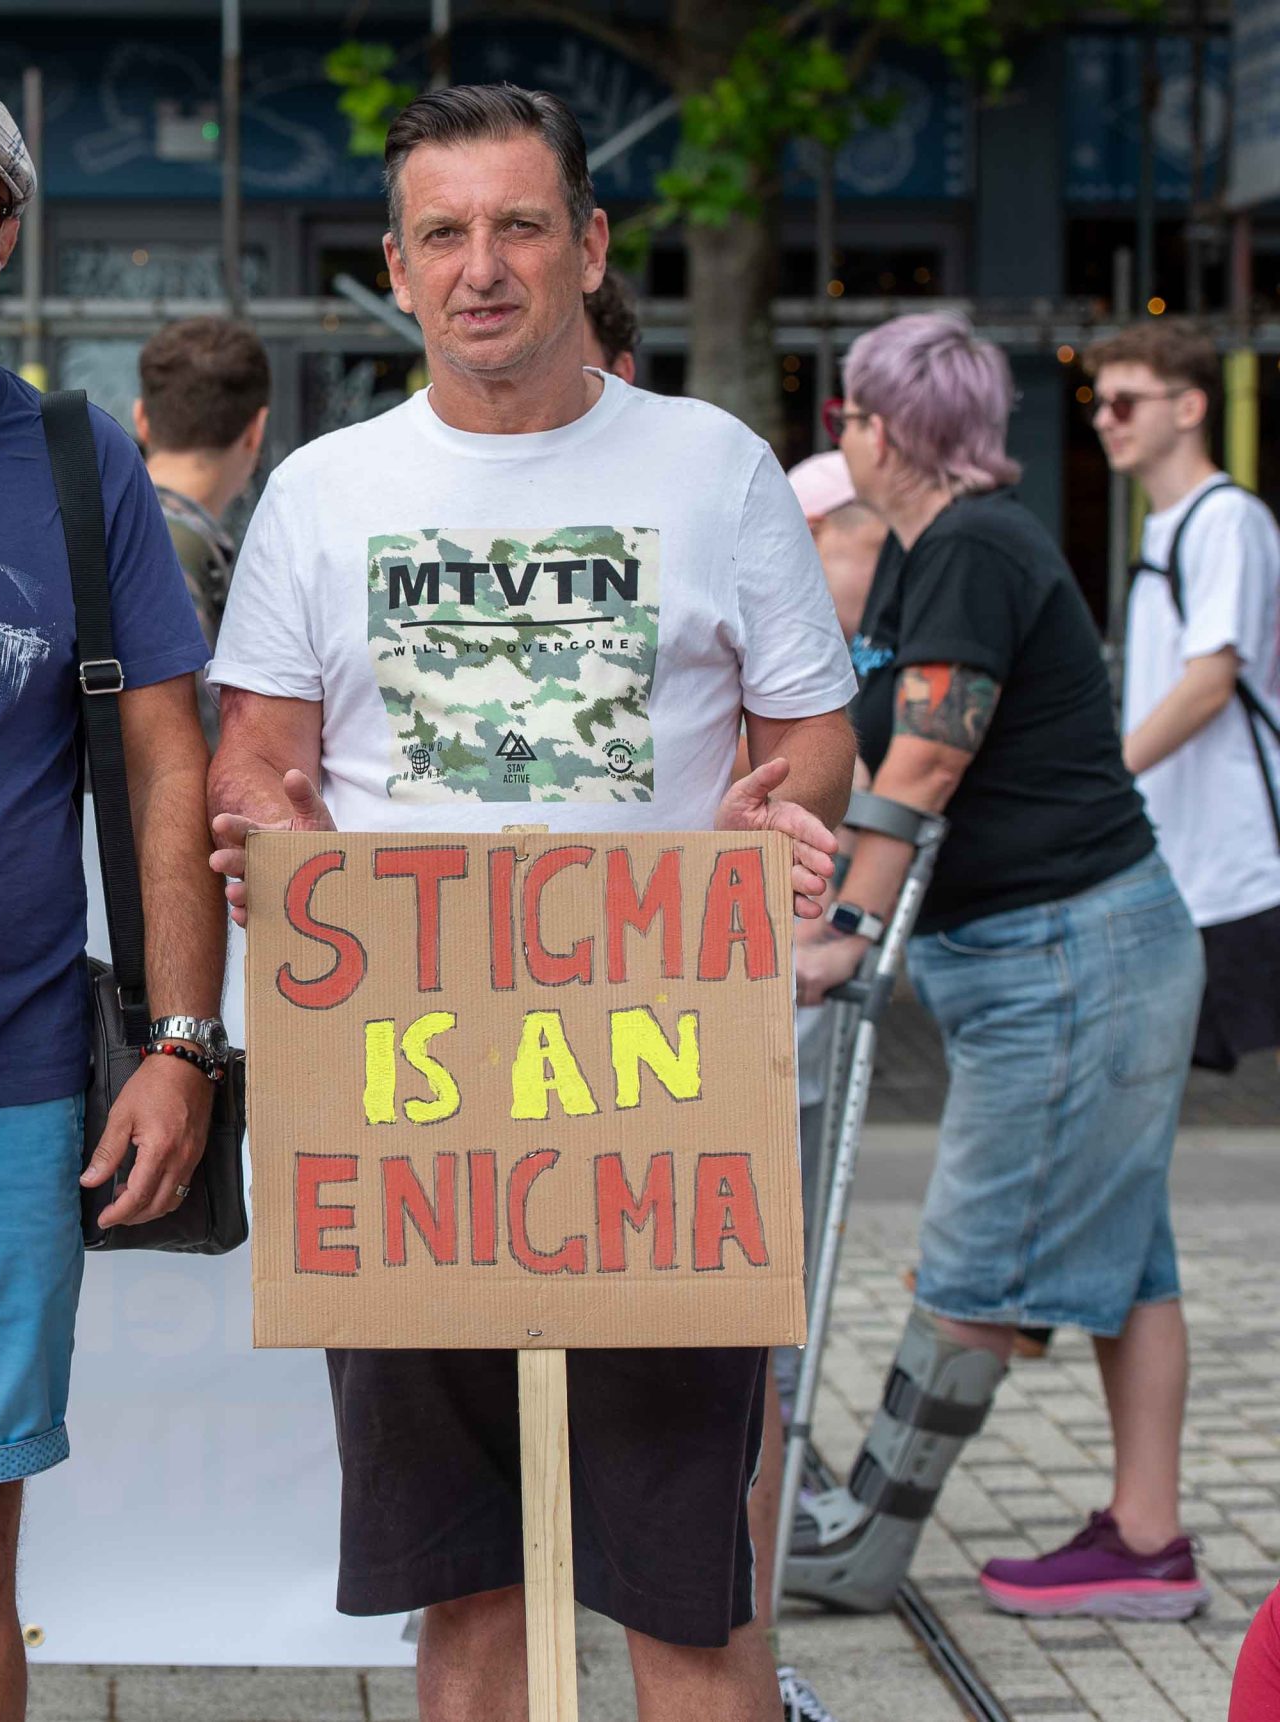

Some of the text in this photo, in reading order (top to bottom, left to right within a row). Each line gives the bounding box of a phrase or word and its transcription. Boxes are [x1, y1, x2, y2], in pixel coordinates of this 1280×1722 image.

[388, 559, 639, 611] MTVTN
[393, 638, 629, 657] WILL TO OVERCOME
[601, 738, 638, 754] CONSTANT
[506, 763, 526, 773] STAY
[614, 754, 626, 764] CM
[503, 774, 531, 784] ACTIVE
[275, 845, 780, 1010] STIGMA
[363, 1005, 703, 1126] IS AN
[293, 1148, 770, 1277] ENIGMA
